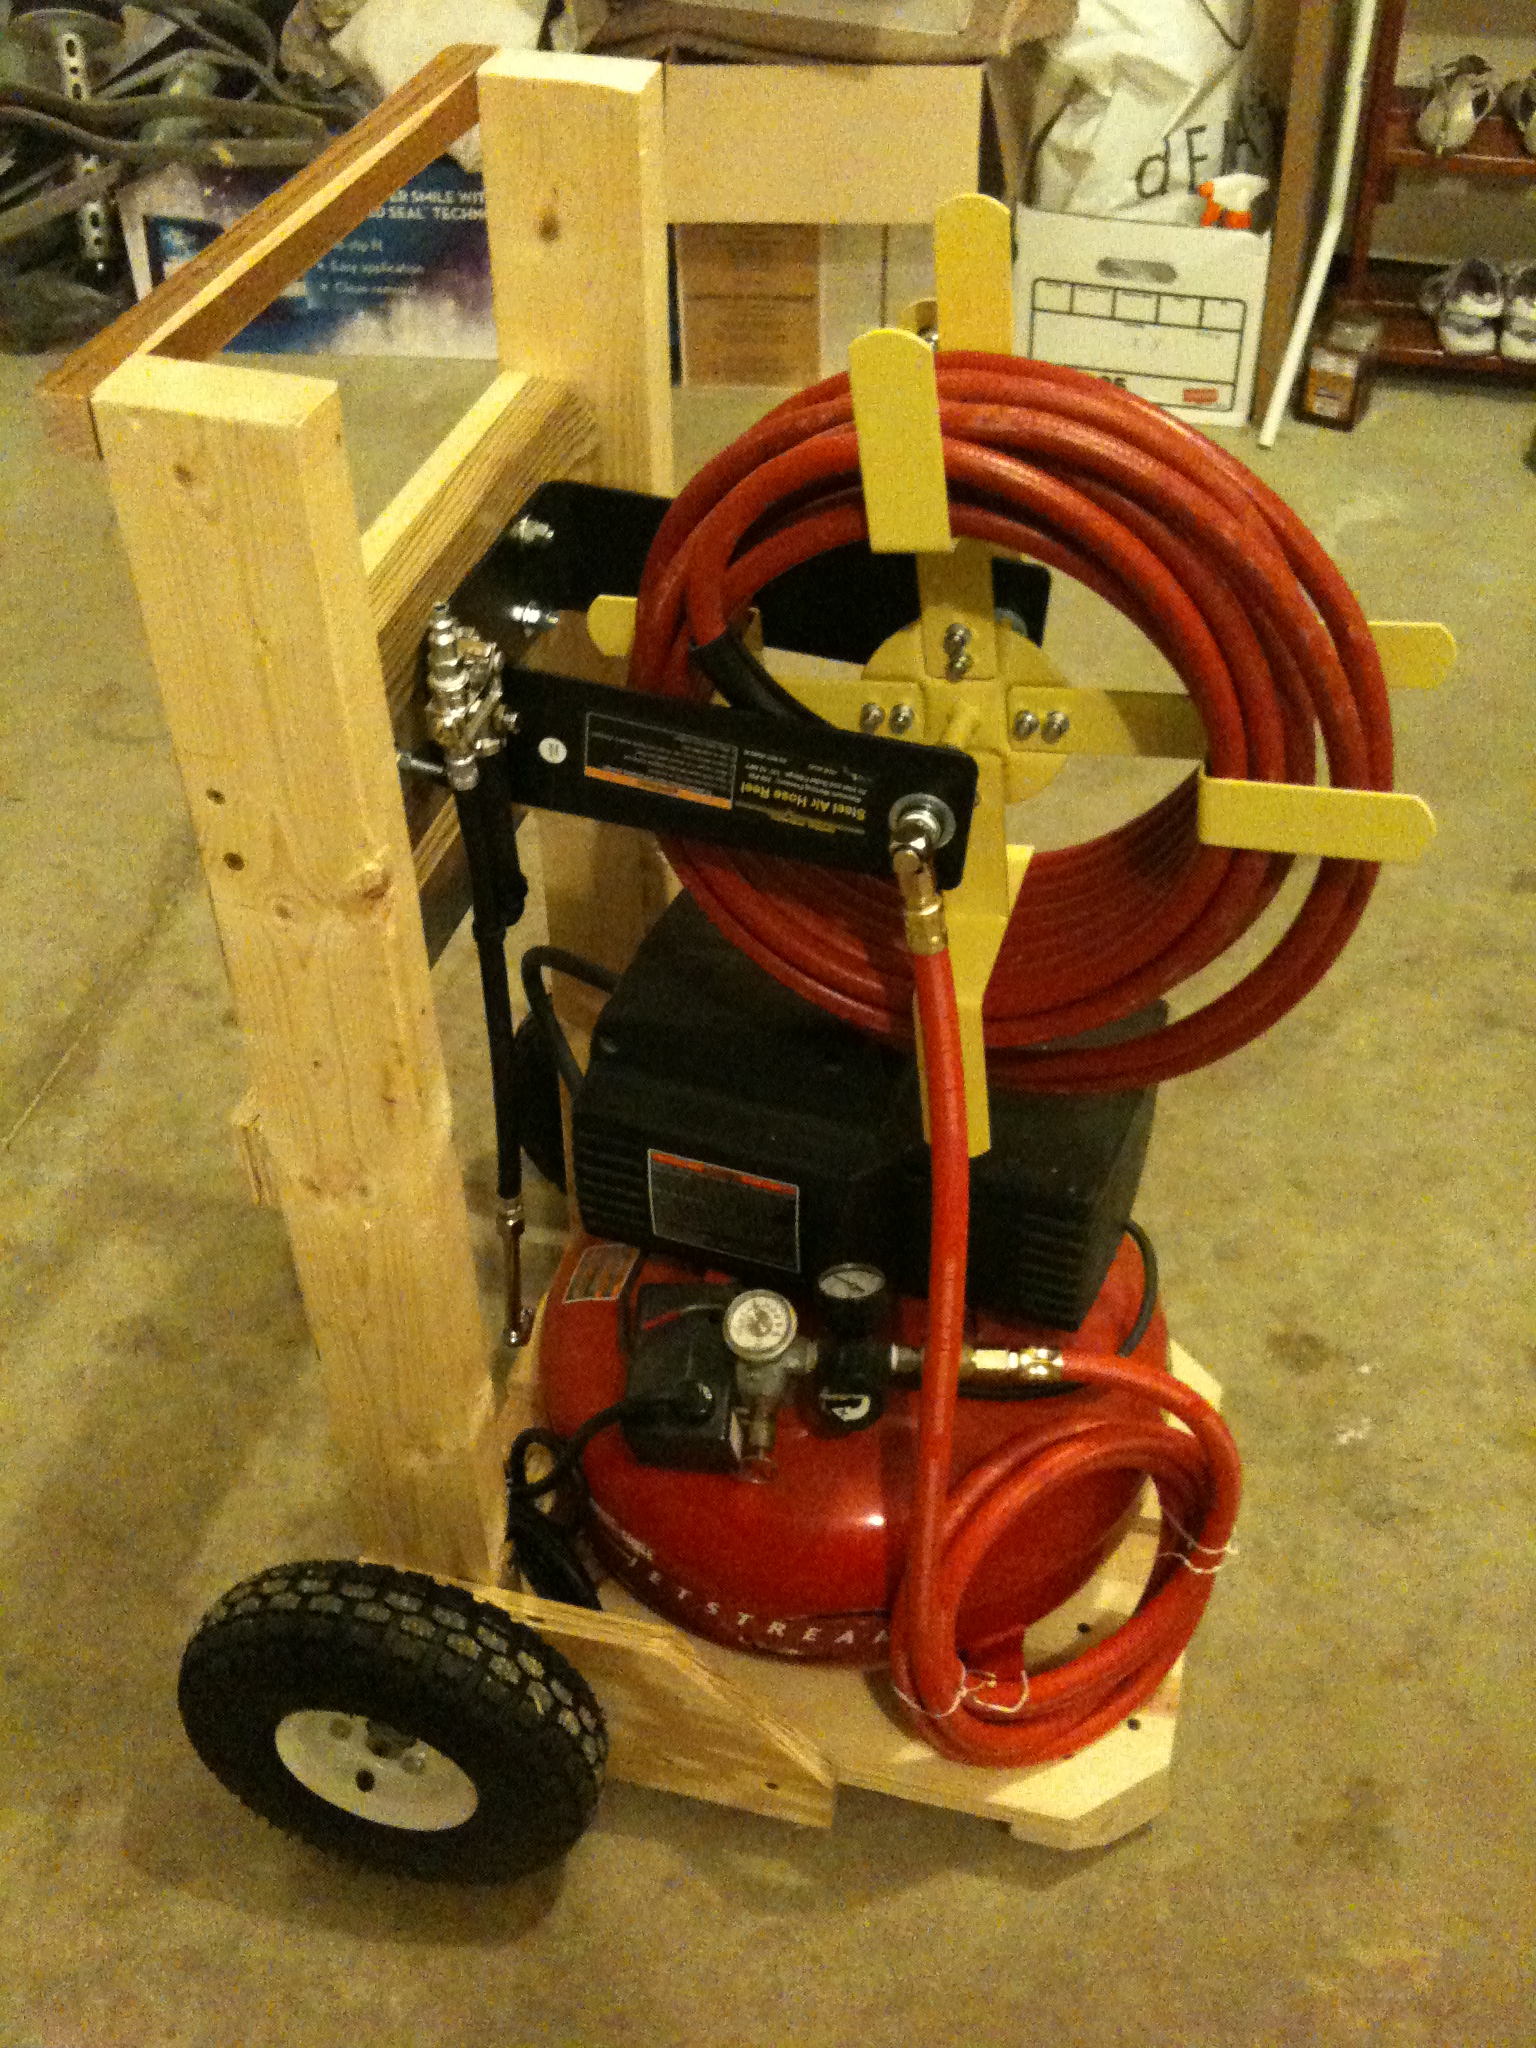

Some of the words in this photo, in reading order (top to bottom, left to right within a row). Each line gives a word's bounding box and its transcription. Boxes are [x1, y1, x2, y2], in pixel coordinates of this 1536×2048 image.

[411, 189, 454, 204] SMILE
[740, 780, 770, 800] Reel
[773, 788, 807, 809] Hose
[810, 797, 831, 813] Air
[832, 802, 866, 821] Steel
